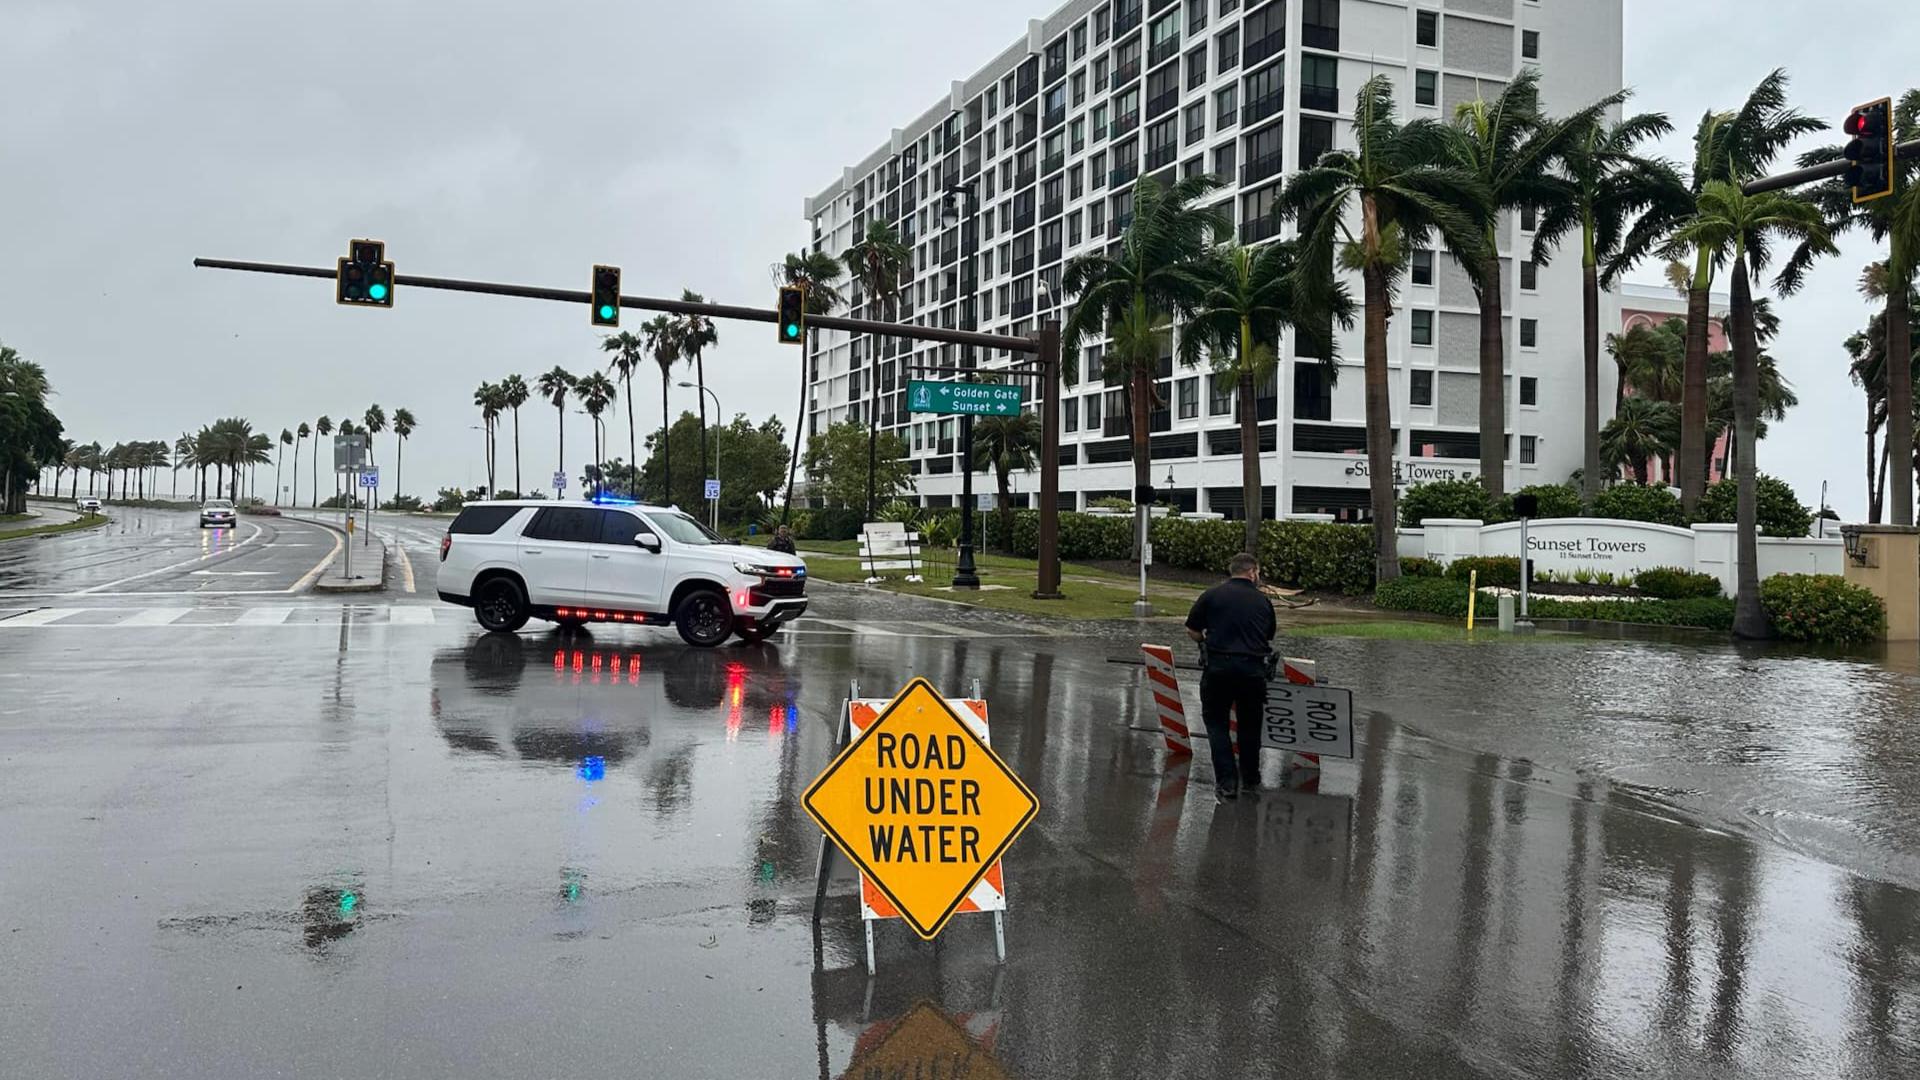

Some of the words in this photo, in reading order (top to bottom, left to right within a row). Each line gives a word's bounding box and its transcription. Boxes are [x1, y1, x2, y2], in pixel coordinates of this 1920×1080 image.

[953, 387, 990, 398] Golden
[994, 389, 1019, 400] Gate
[952, 400, 991, 412] Sunset
[1406, 463, 1456, 480] Towers
[362, 476, 377, 485] 35
[706, 489, 719, 497] 35
[1526, 536, 1582, 551] Sunset
[1586, 537, 1647, 552] Towers
[1568, 552, 1592, 560] Sunset
[1593, 552, 1613, 560] Drive
[1306, 700, 1338, 742] ROAD
[877, 732, 967, 770] ROAD
[865, 777, 981, 816] UNDER
[869, 825, 981, 863] WATER
